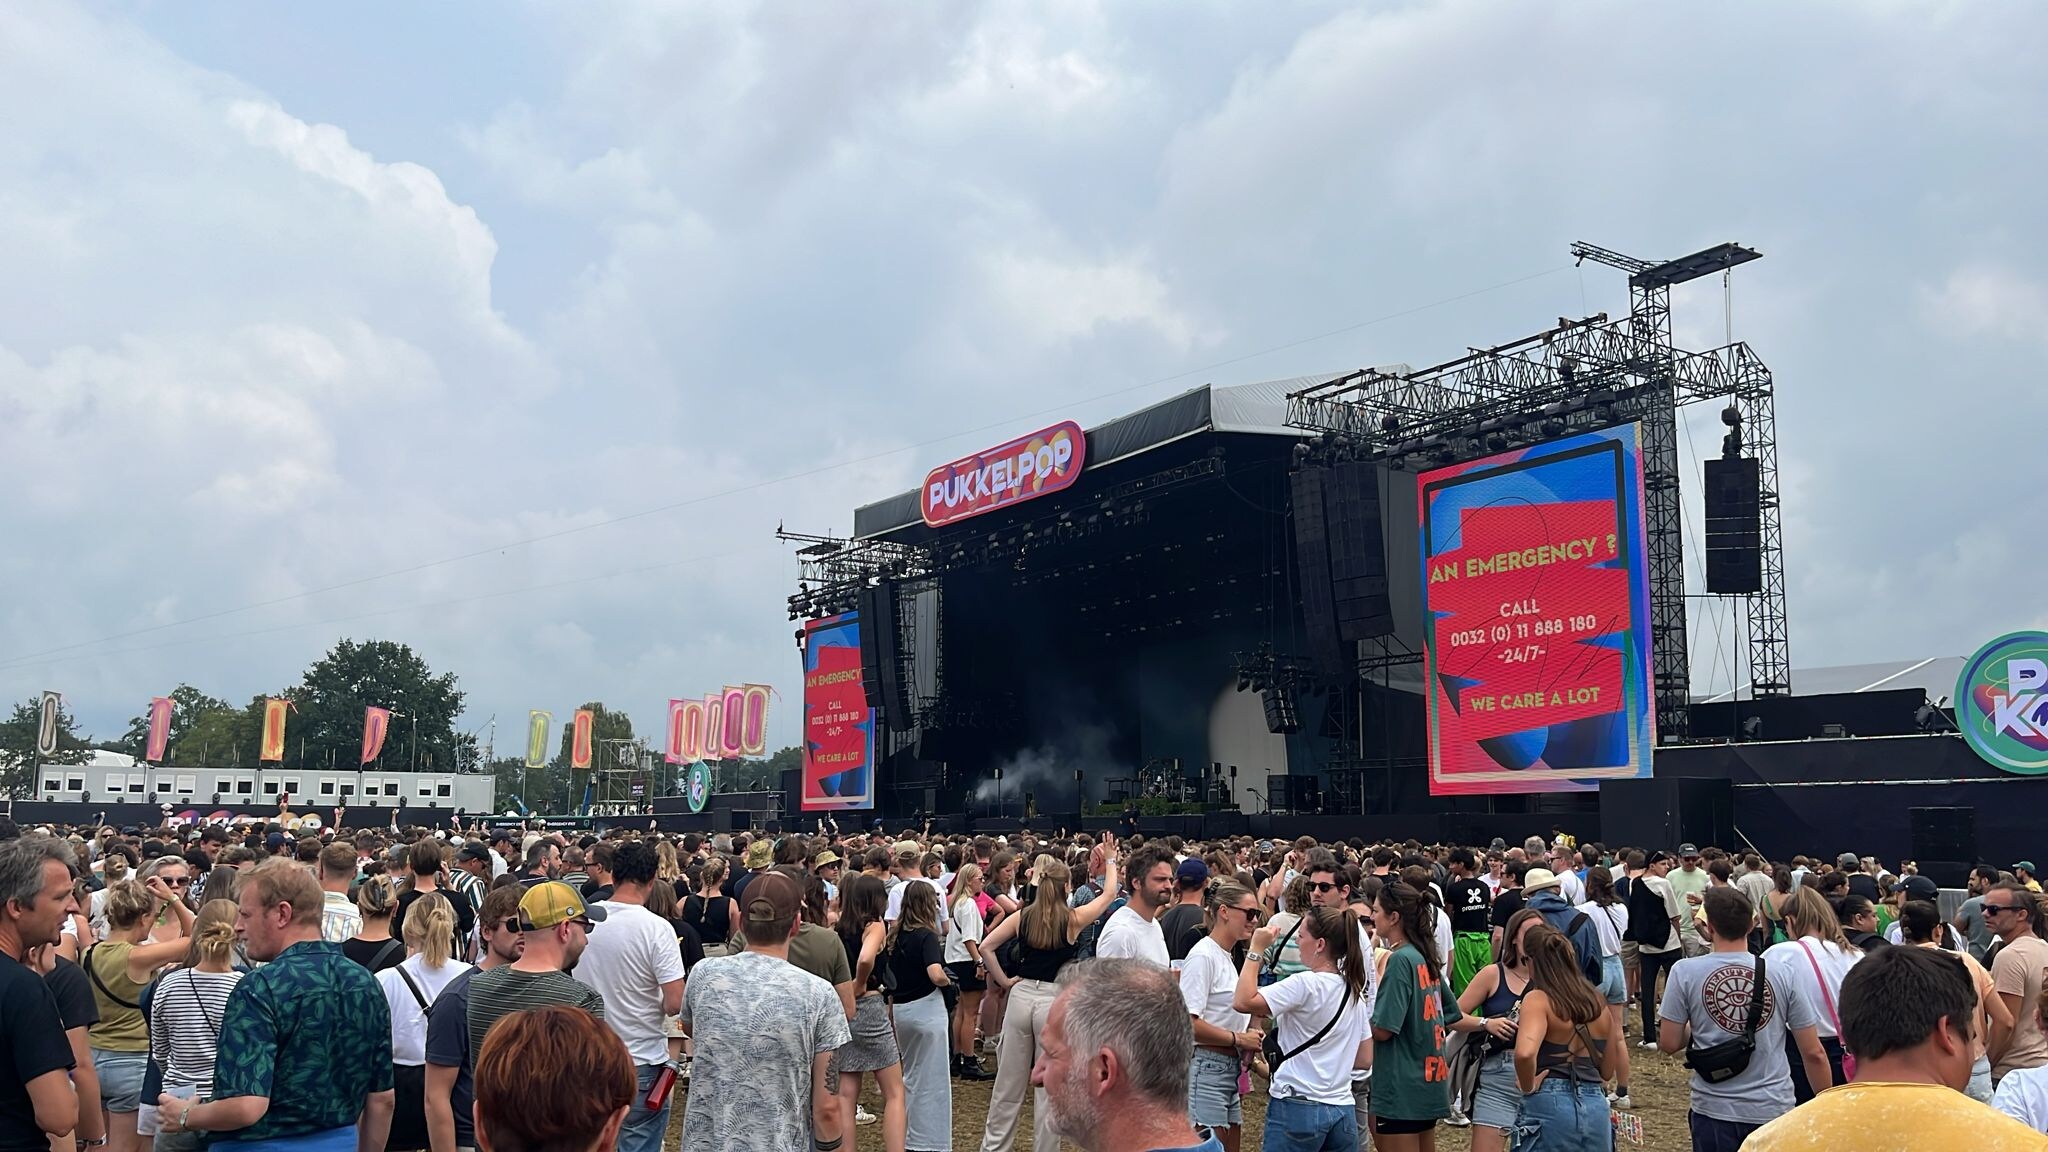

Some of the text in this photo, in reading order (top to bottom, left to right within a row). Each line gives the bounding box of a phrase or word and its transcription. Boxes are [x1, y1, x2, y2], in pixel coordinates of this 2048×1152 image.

[929, 438, 1072, 513] PUKKELPOP
[1429, 562, 1458, 584] AN
[1466, 537, 1598, 578] EMERGENCY
[1500, 598, 1540, 618] CALL
[1451, 615, 1597, 647] 0032 (0) 11 888 180
[1497, 645, 1546, 664] -24/7-
[807, 669, 862, 688] AN EMERGENCY
[828, 700, 842, 710] CALL
[1471, 687, 1600, 712] WE CARE A LOT
[817, 751, 859, 763] WE CARE A LOT
[1707, 968, 1750, 992] BEAUTY
[1706, 995, 1721, 1021] THE
